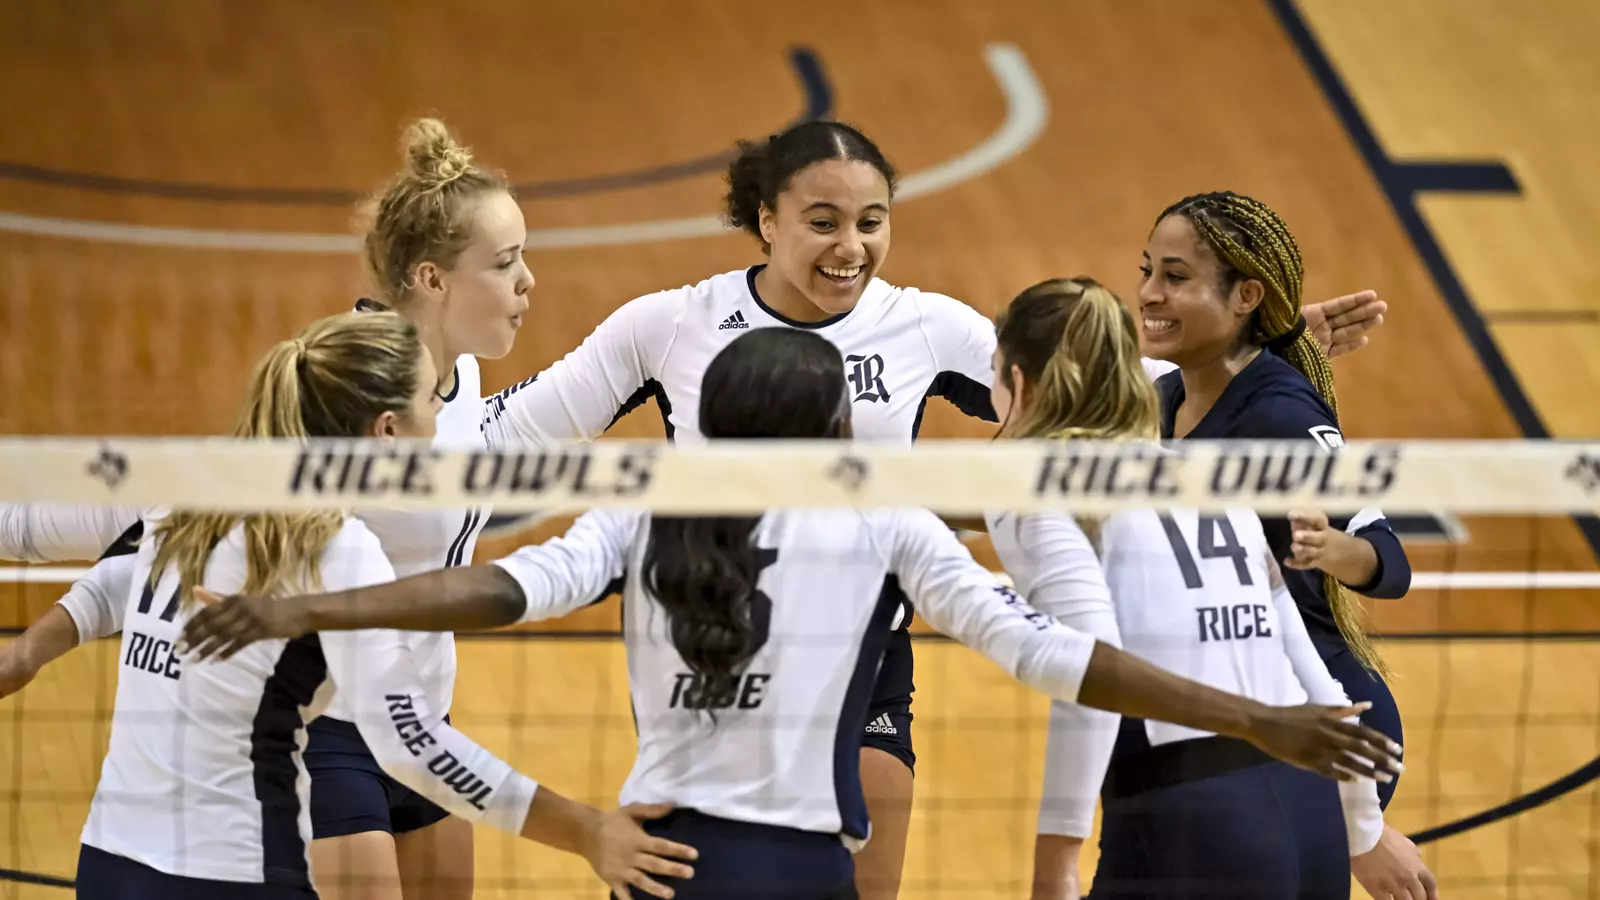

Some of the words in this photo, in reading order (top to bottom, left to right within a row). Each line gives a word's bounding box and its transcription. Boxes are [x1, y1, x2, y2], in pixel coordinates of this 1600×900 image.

[719, 321, 749, 330] adidas
[289, 449, 442, 496] RICE
[462, 449, 655, 496] OWLS
[1035, 451, 1187, 496] RICE
[1210, 451, 1400, 496] OWLS
[1155, 508, 1255, 589] 14
[1195, 603, 1272, 643] RICE
[125, 631, 181, 681] RICE
[385, 694, 437, 757] RICE
[428, 749, 493, 811] OWL
[865, 725, 897, 734] adidas
